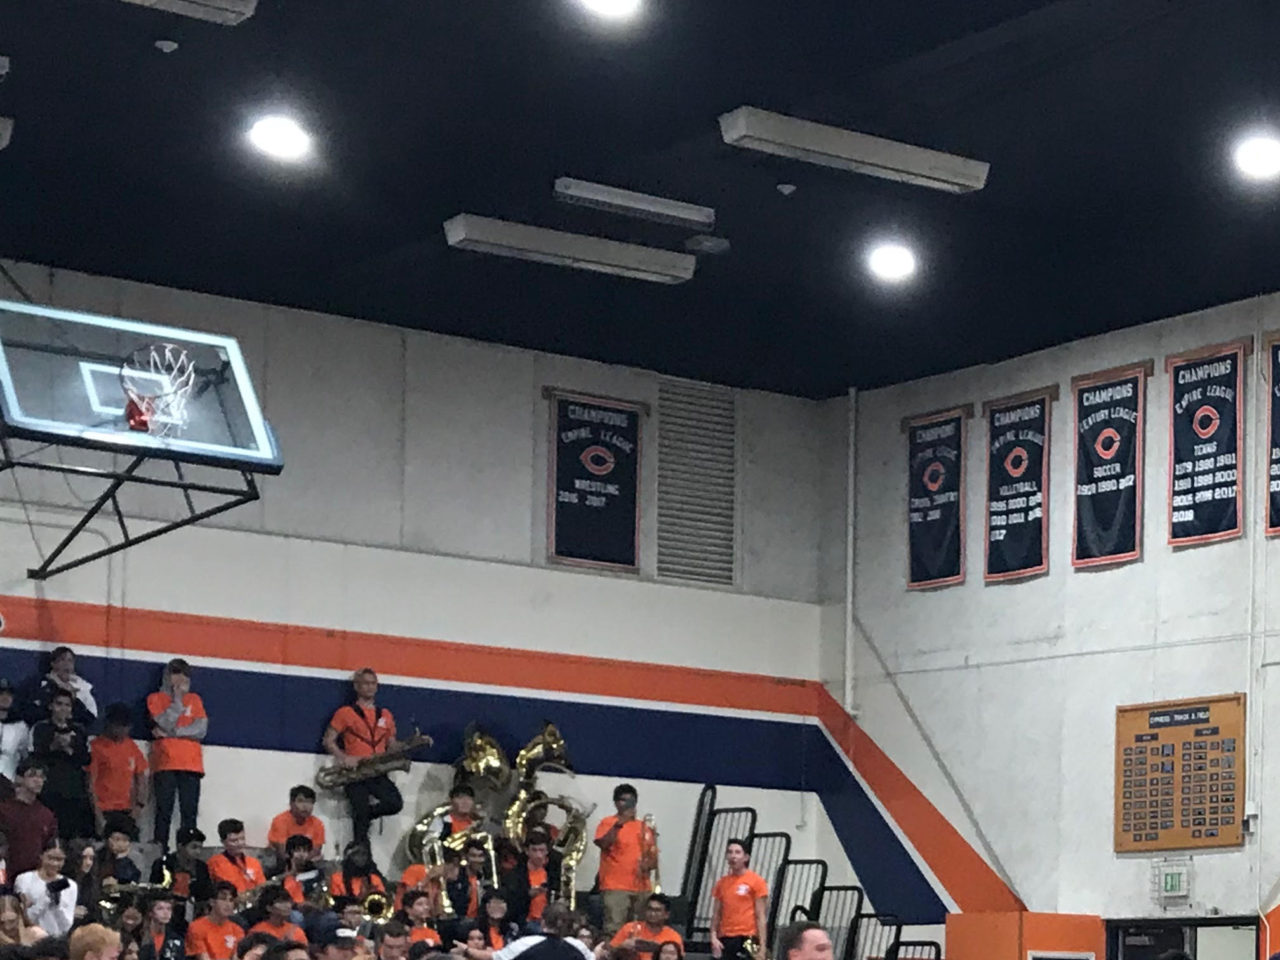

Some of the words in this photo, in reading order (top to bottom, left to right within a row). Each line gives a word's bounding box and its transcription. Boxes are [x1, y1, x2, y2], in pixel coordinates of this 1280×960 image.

[1178, 360, 1231, 384] CHAMPIONS
[1083, 383, 1133, 406] CHAMPIONS
[1175, 388, 1203, 414] EMPIRE
